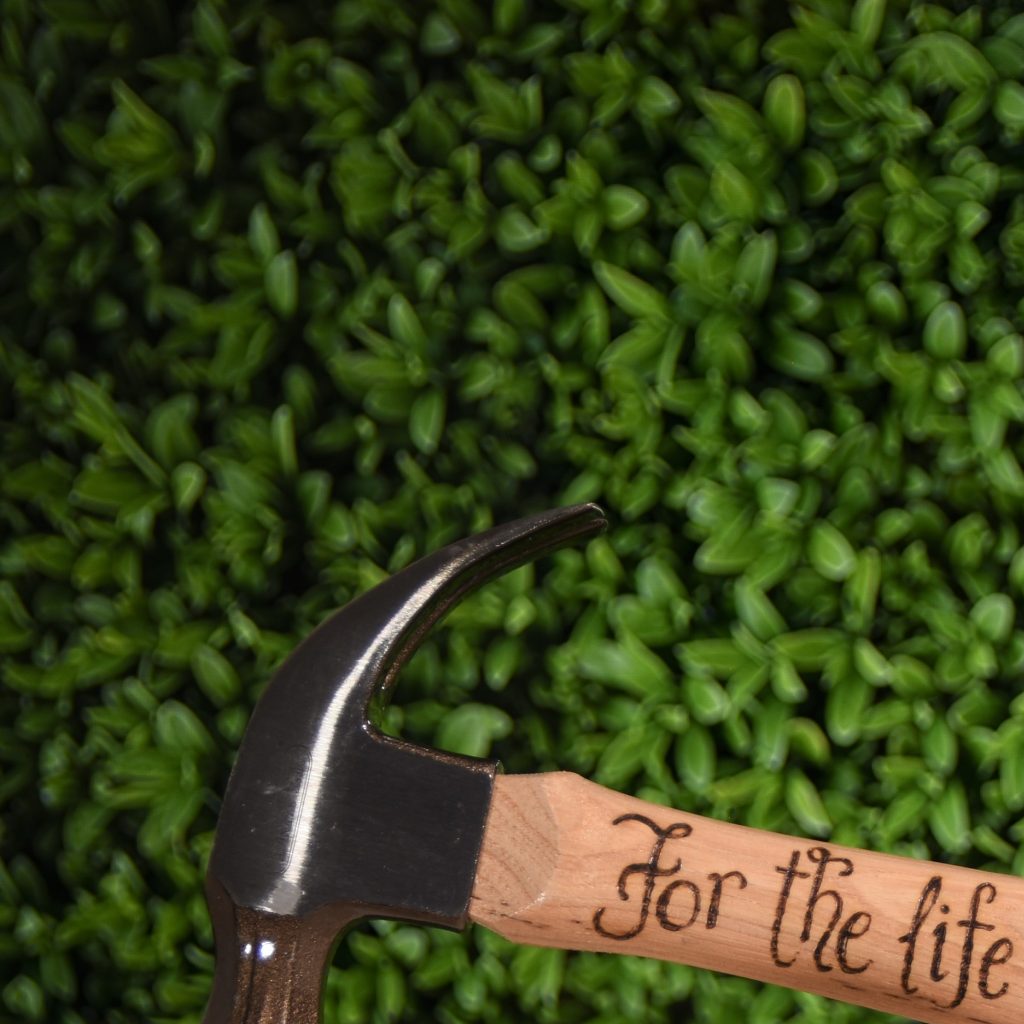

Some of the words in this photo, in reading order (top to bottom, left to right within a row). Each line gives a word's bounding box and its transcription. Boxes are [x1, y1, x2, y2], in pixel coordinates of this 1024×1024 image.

[592, 812, 748, 941] For
[769, 846, 875, 975] the
[897, 875, 1014, 1010] life
